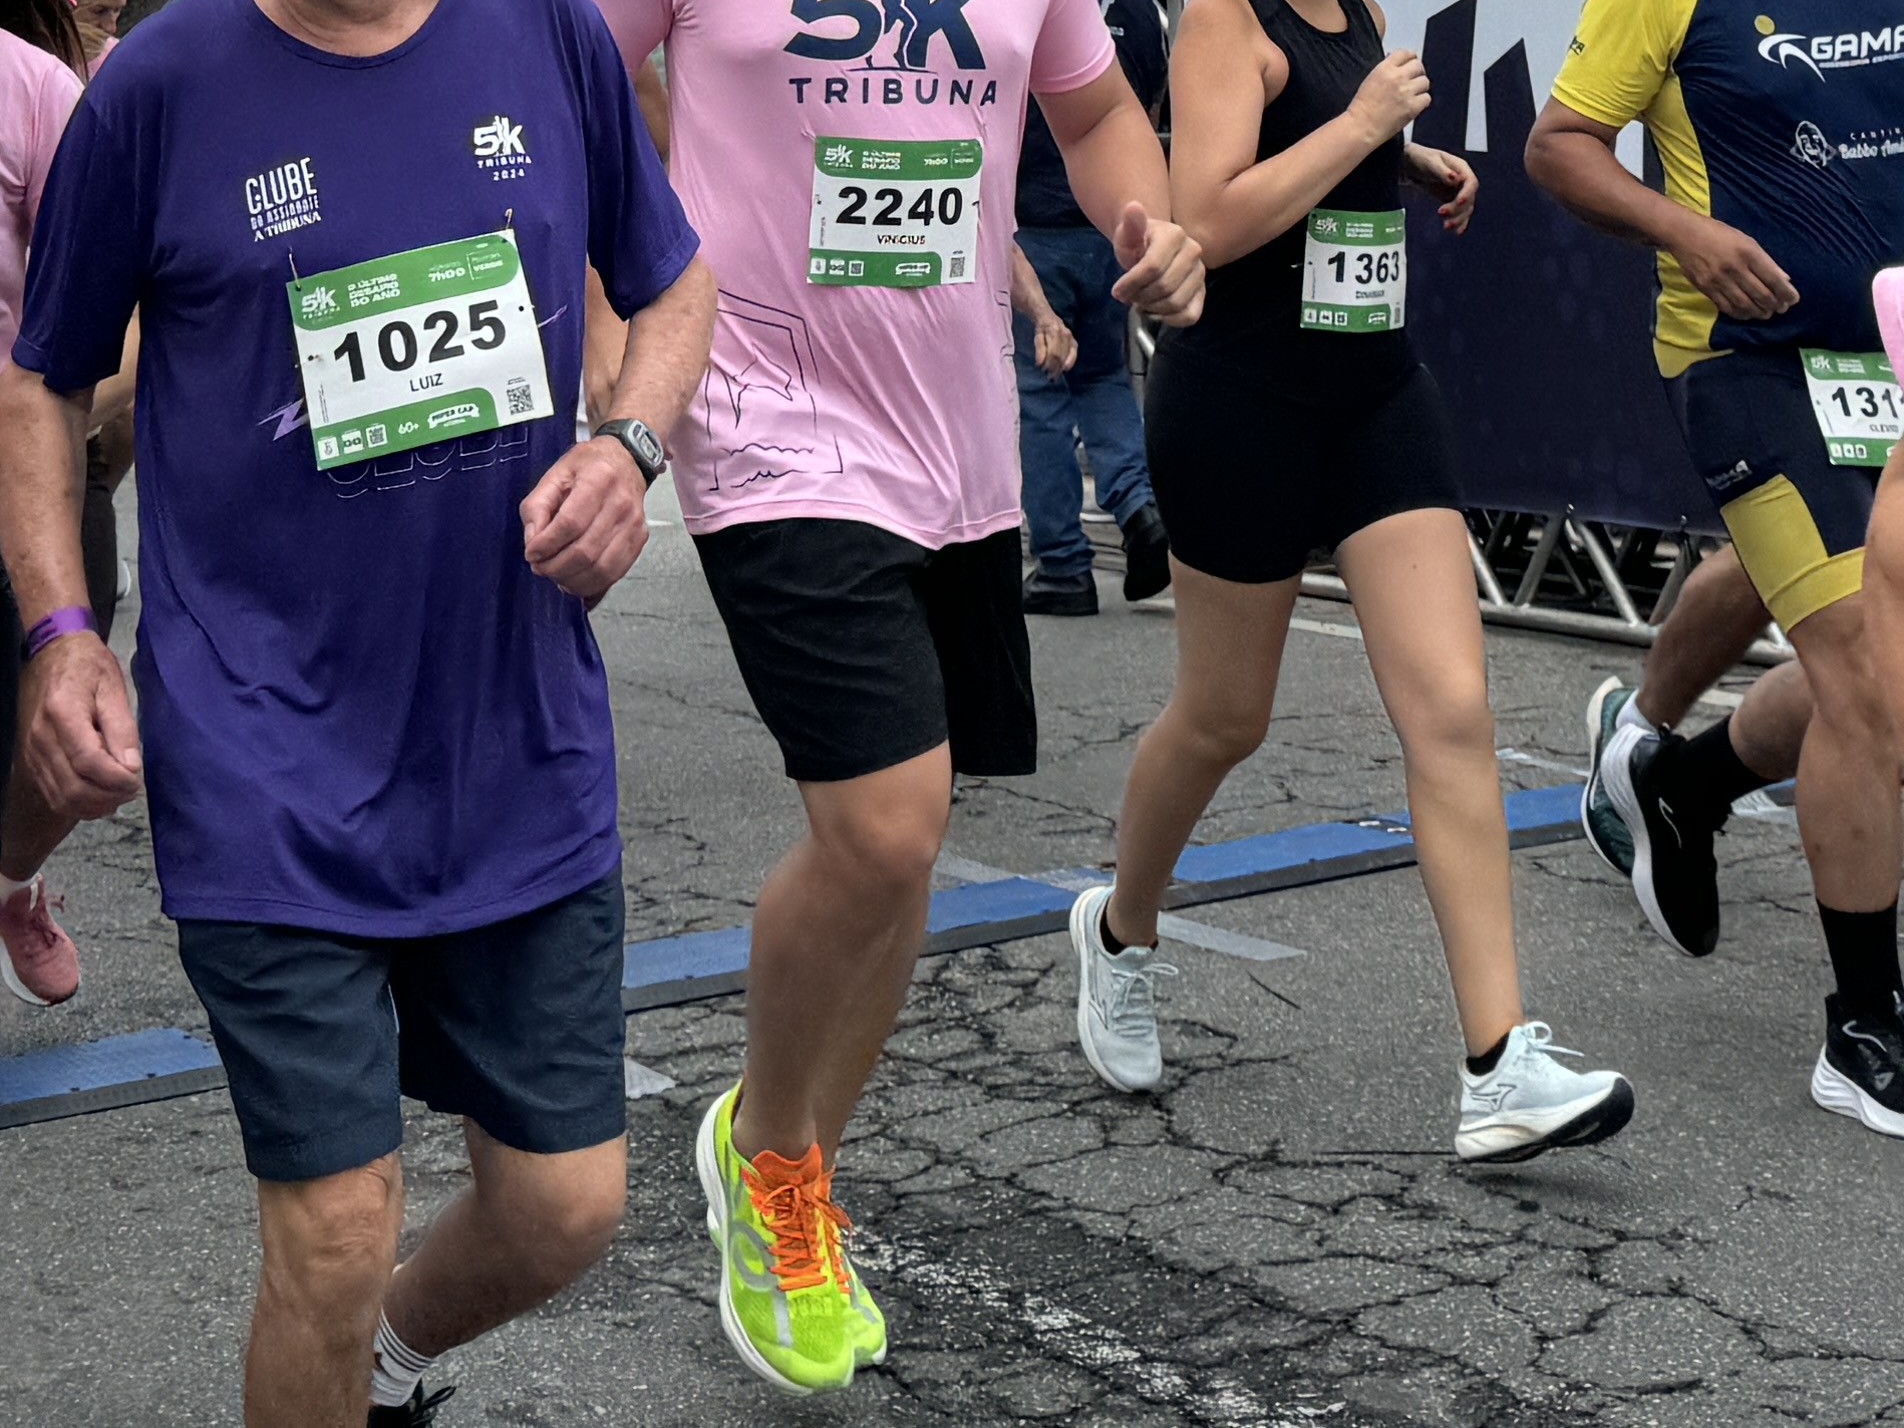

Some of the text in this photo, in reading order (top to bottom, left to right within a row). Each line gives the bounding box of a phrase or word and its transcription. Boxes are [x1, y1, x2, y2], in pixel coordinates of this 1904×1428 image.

[788, 77, 997, 107] TRIBUNA
[477, 156, 532, 169] TRIBUNA
[245, 157, 318, 215] CLUBE
[835, 186, 963, 226] 2240
[1327, 250, 1400, 285] 1363
[333, 299, 506, 383] 1025
[409, 373, 443, 392] LUIZ
